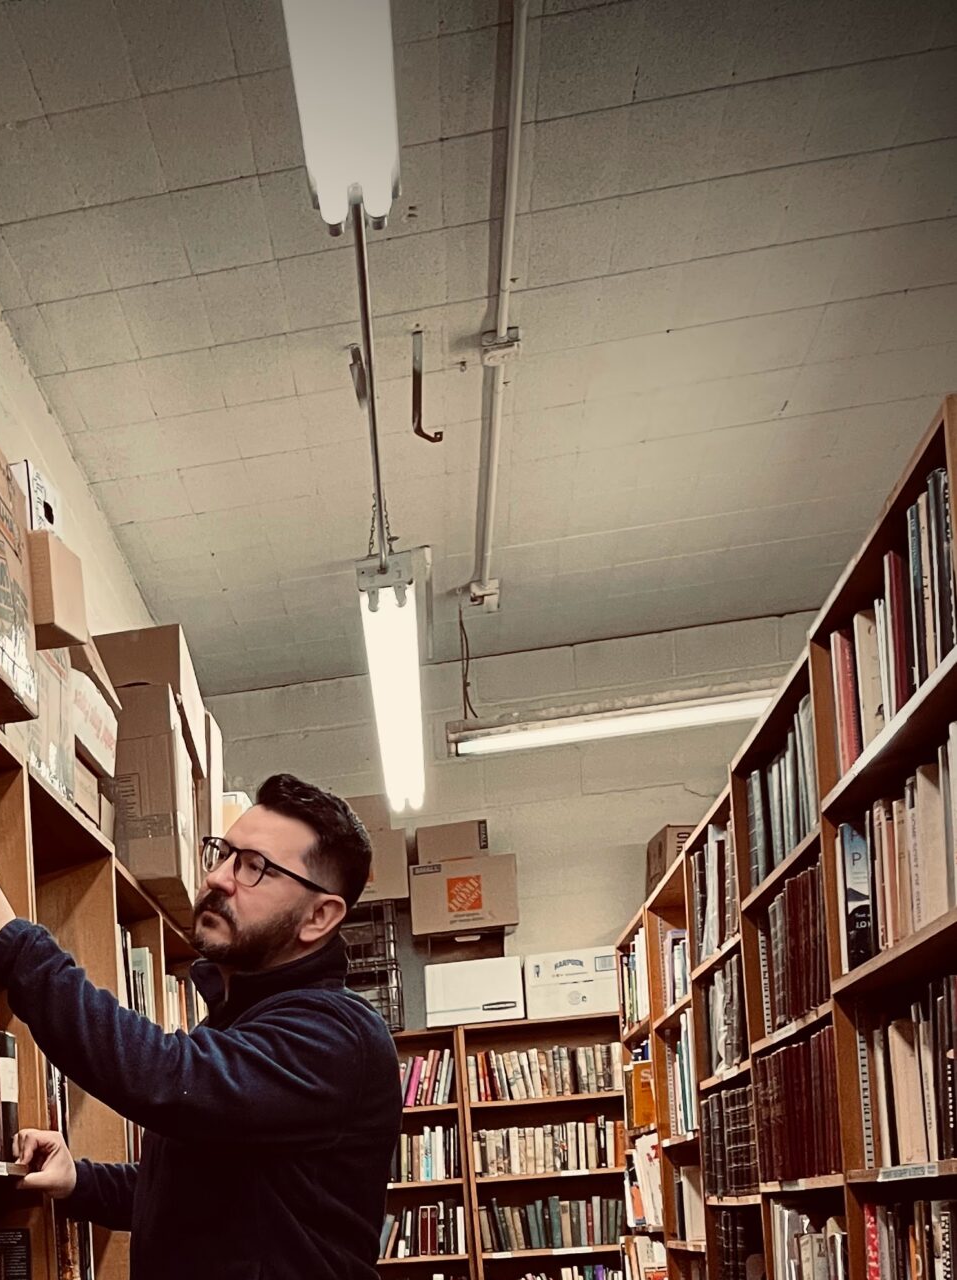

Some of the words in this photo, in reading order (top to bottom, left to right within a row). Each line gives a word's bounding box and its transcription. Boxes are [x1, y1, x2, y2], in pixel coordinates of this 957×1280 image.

[910, 811, 918, 838] SOME
[911, 841, 920, 868] SORT
[447, 877, 480, 912] HOME
